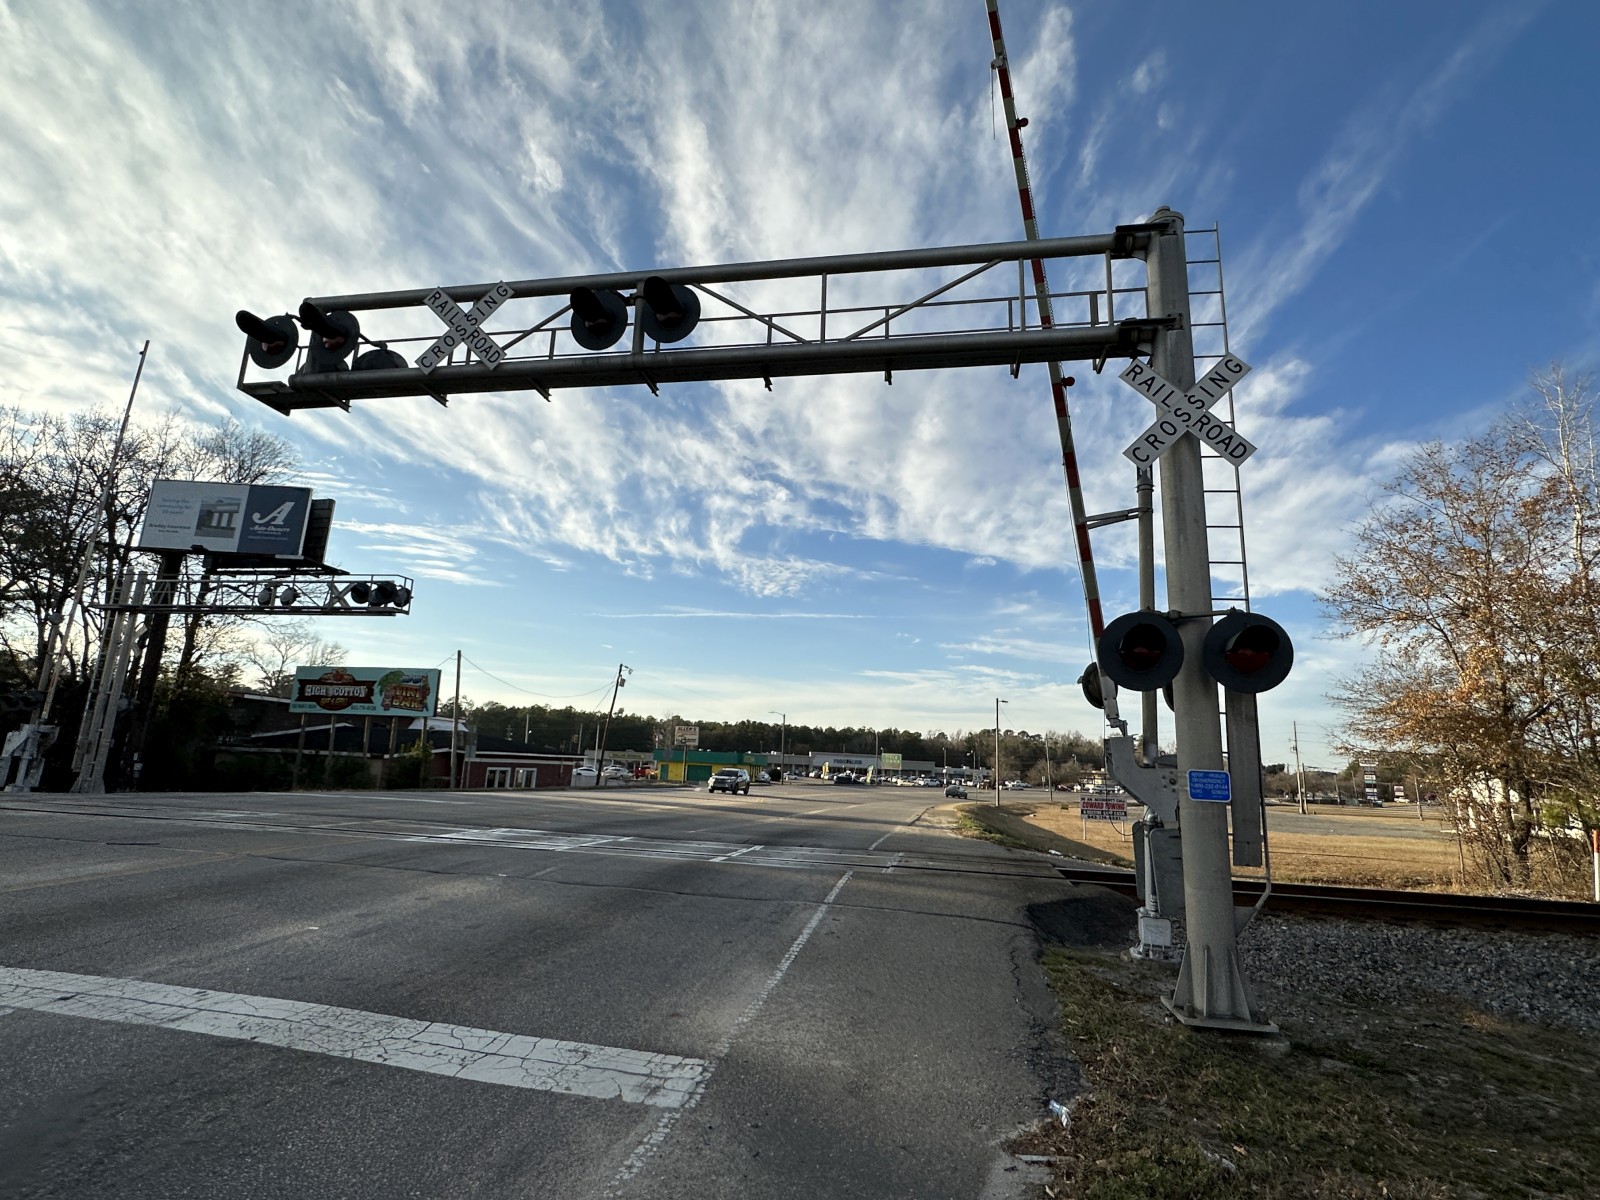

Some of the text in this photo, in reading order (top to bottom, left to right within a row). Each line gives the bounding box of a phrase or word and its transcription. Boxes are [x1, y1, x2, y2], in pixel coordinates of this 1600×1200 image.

[420, 285, 508, 368] CROSSING
[1132, 359, 1243, 463] CROSSING
[304, 684, 368, 698] HIGH COTTON
[394, 686, 420, 698] TIKI
[391, 699, 419, 708] BAR
[1082, 801, 1126, 811] COWARD TOWING
